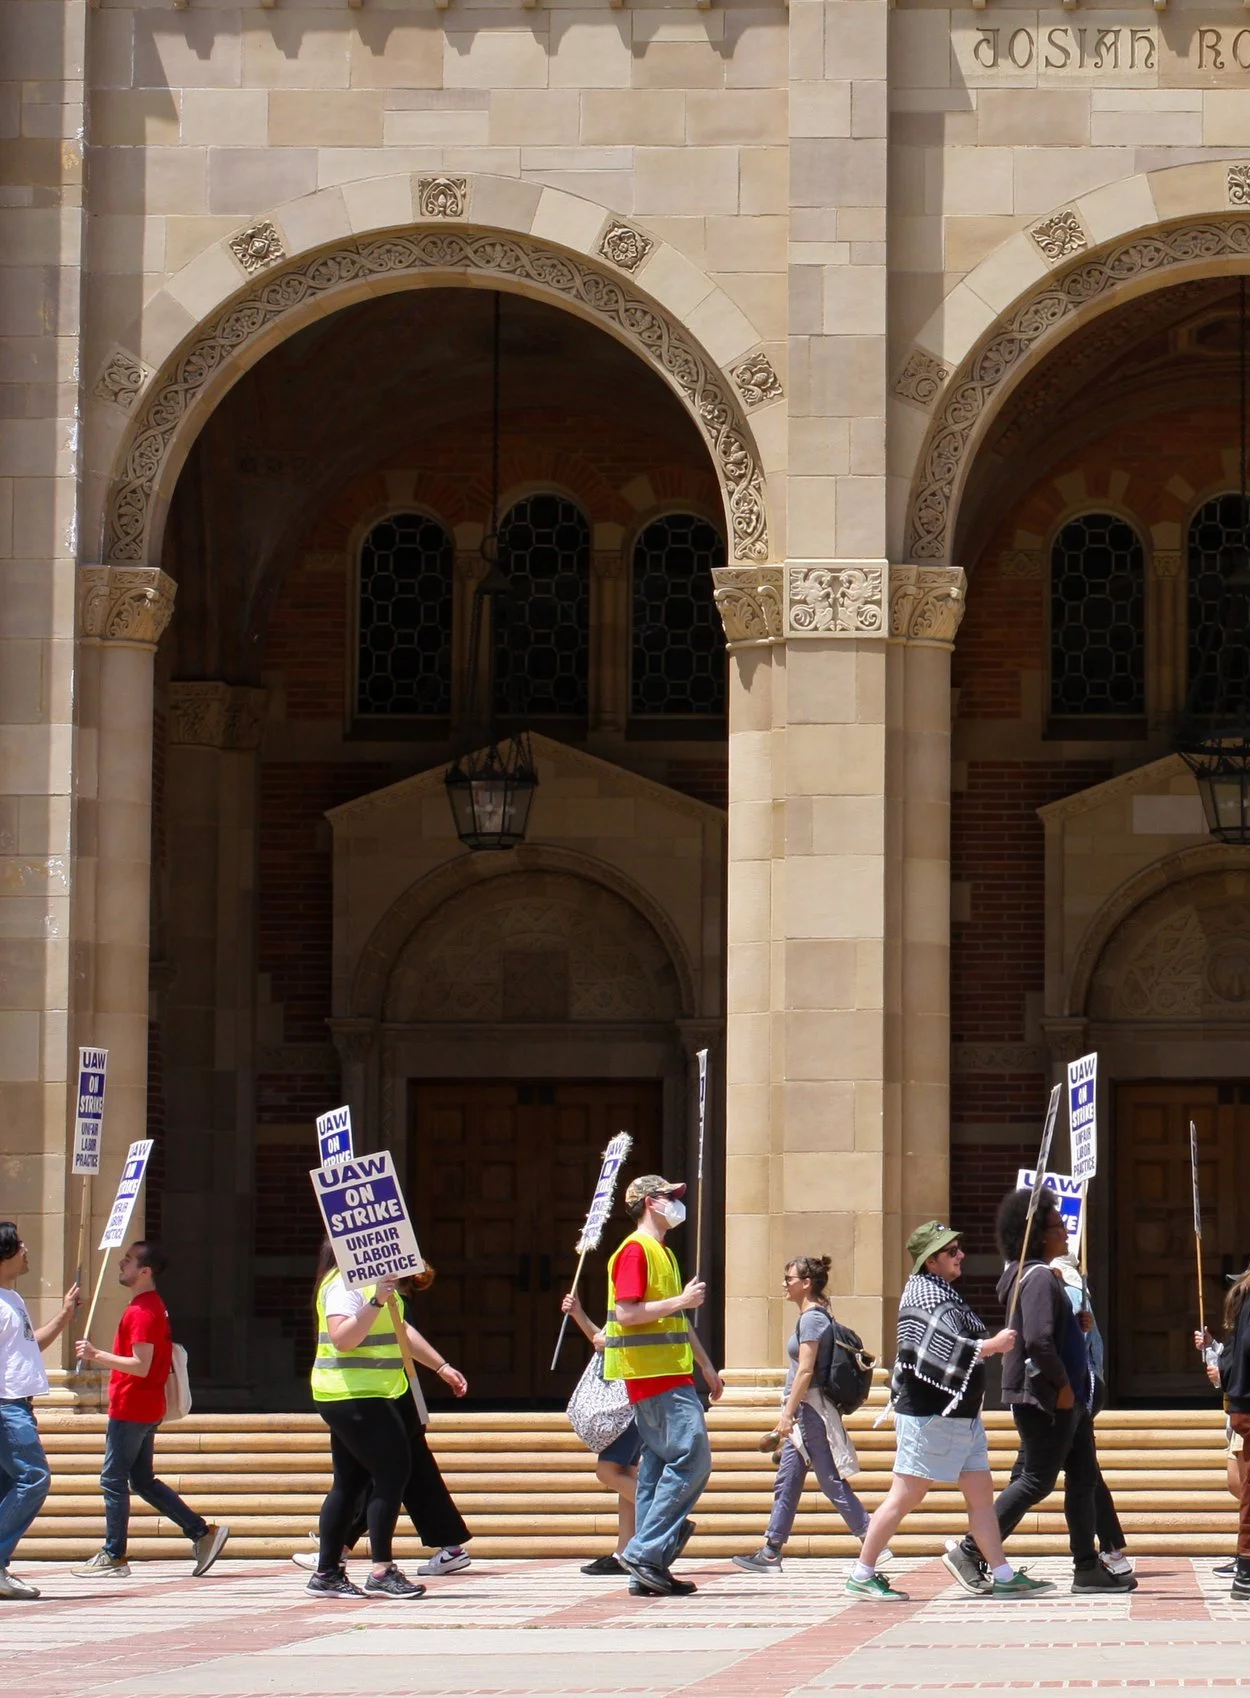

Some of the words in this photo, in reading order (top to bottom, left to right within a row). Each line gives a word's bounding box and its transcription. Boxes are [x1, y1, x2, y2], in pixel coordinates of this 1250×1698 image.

[973, 26, 1156, 71] JOSIAH
[83, 1051, 105, 1070] UAW
[1070, 1057, 1095, 1084] UAW
[89, 1075, 100, 1094] ON
[1078, 1084, 1087, 1106] ON
[79, 1094, 103, 1114] STRIKE
[1072, 1102, 1094, 1129] STRIKE
[318, 1110, 348, 1136] UAW
[327, 1135, 340, 1154] ON
[318, 1156, 386, 1188] UAW
[345, 1184, 375, 1207] ON
[331, 1199, 401, 1232] STRIKE
[345, 1226, 400, 1251] UNFAIR
[353, 1242, 401, 1266] LABOR
[347, 1253, 418, 1283] PRACTICE
